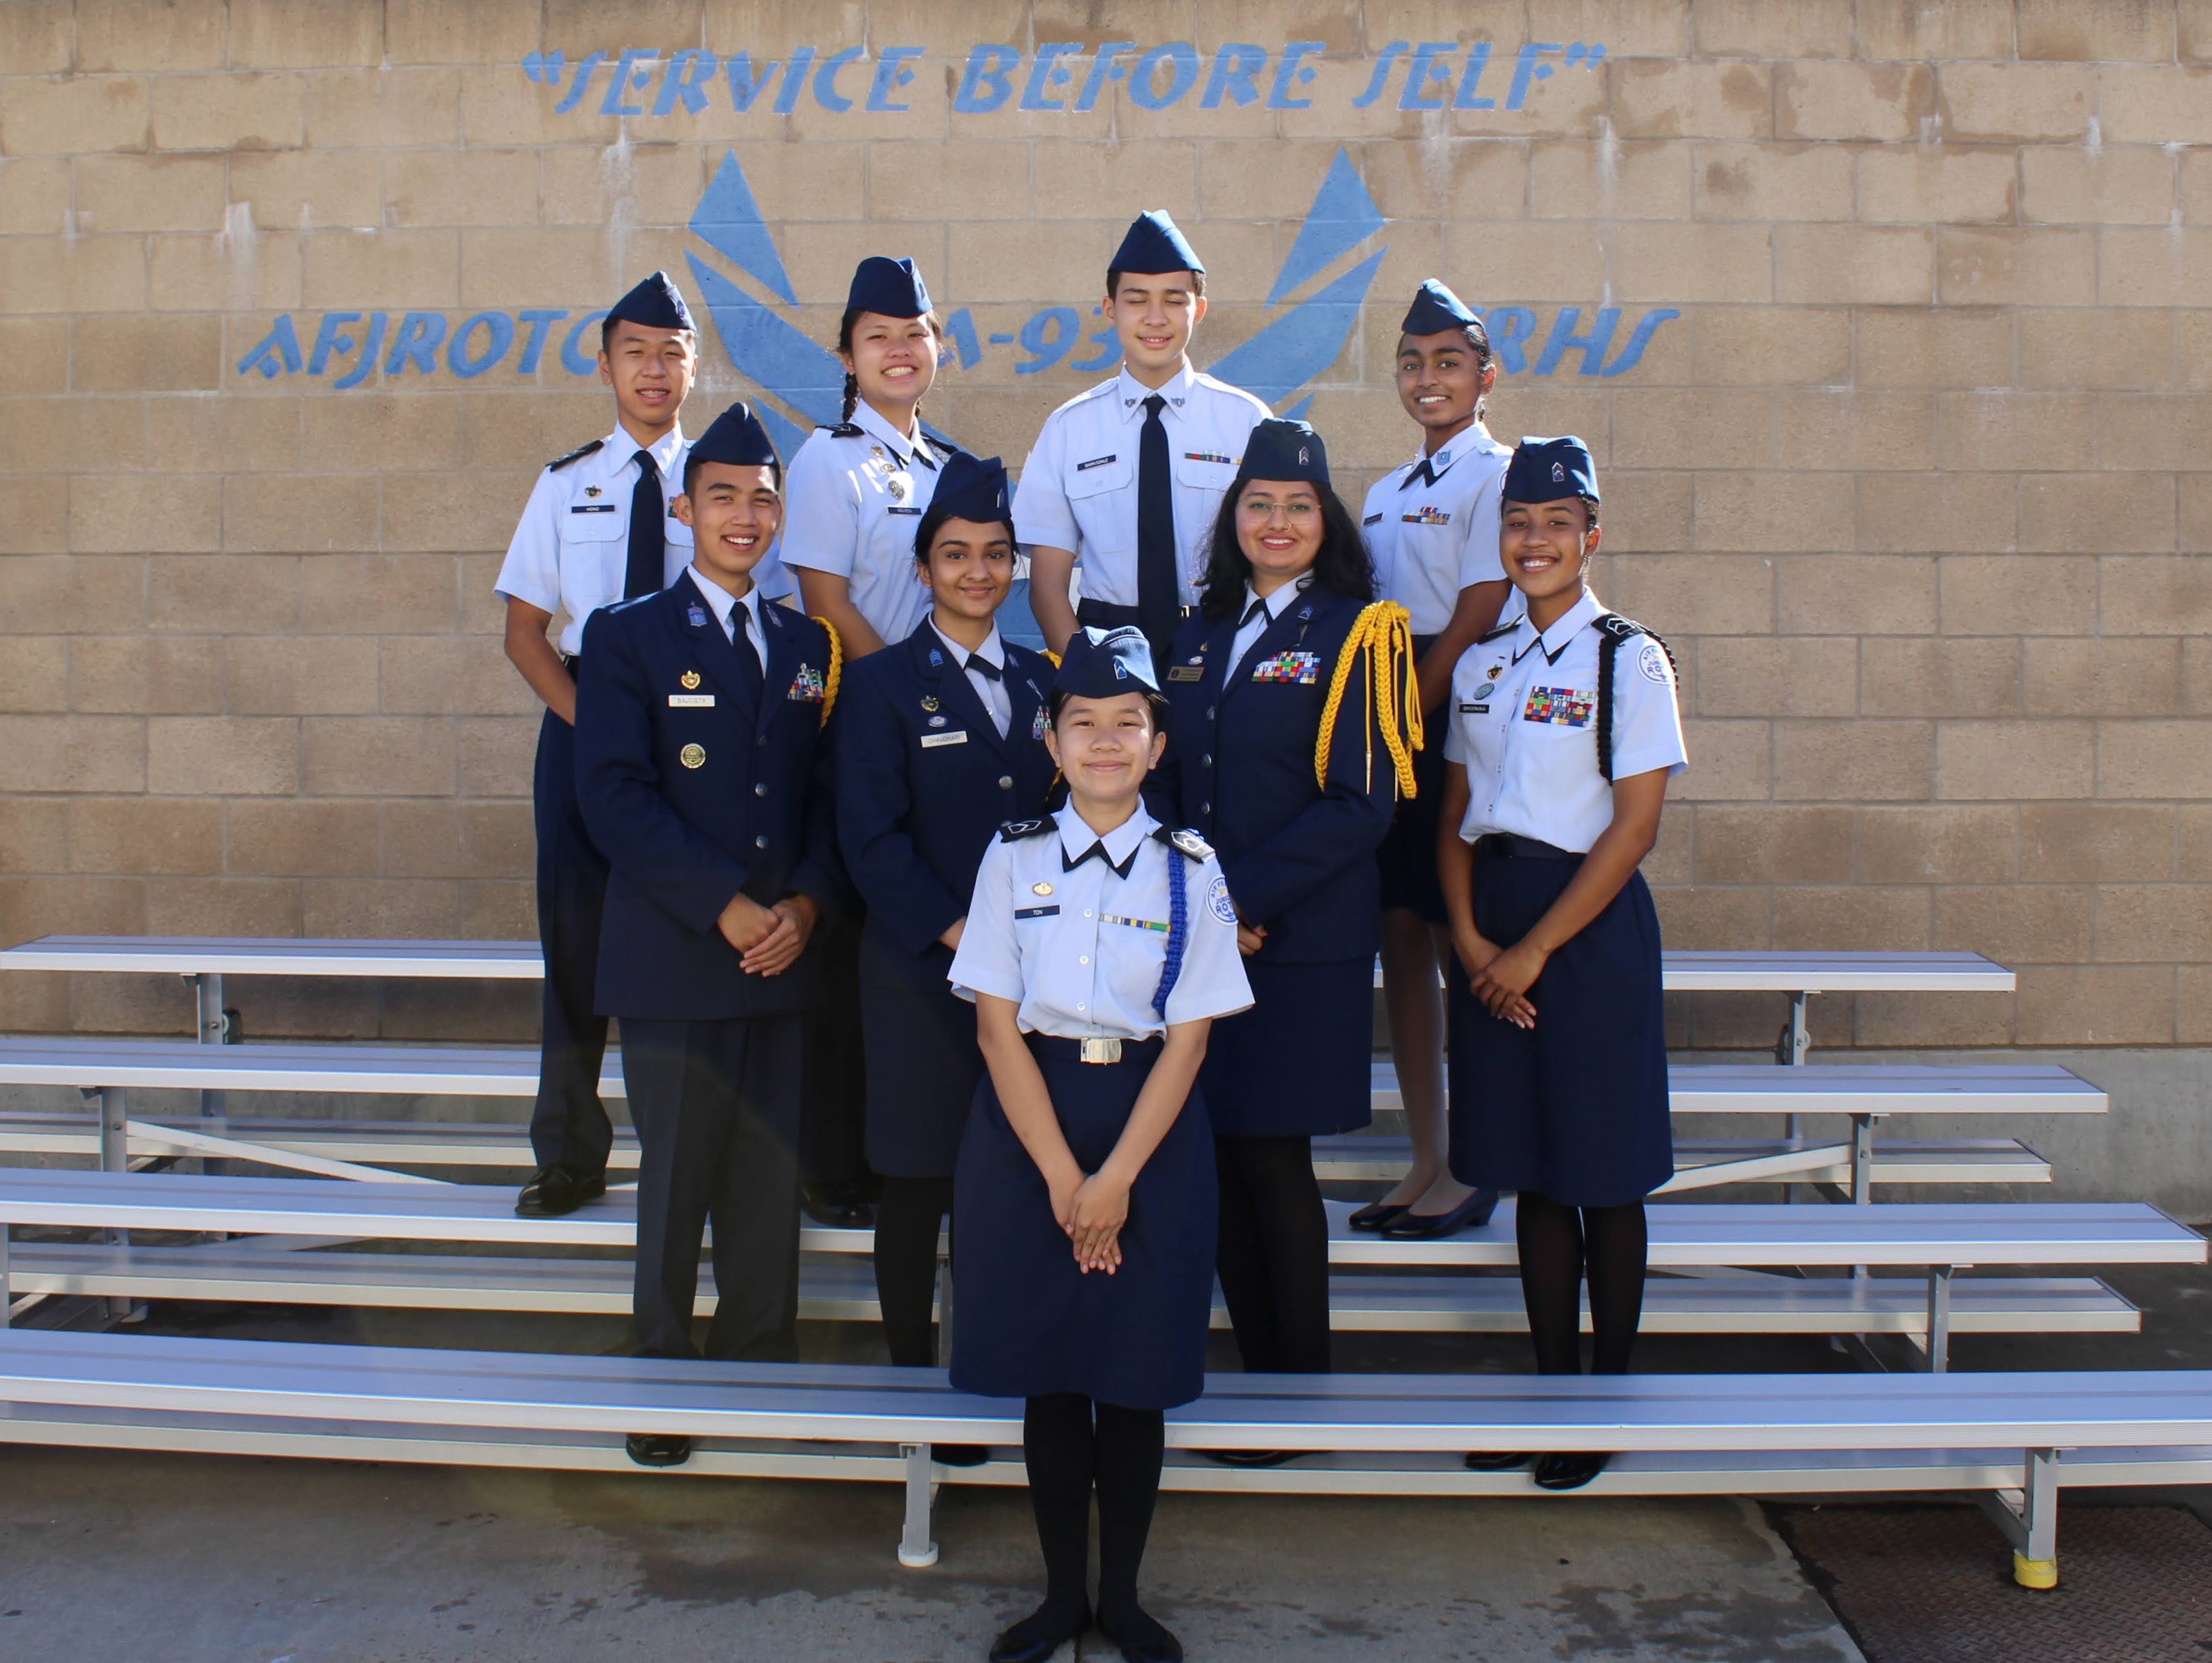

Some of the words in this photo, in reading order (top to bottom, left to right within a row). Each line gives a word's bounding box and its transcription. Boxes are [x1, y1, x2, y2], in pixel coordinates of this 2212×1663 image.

[953, 42, 1325, 112] BEFORE
[237, 309, 612, 390] AFJROTC
[1471, 305, 1680, 377] RHS
[1215, 901, 1233, 914] ROT
